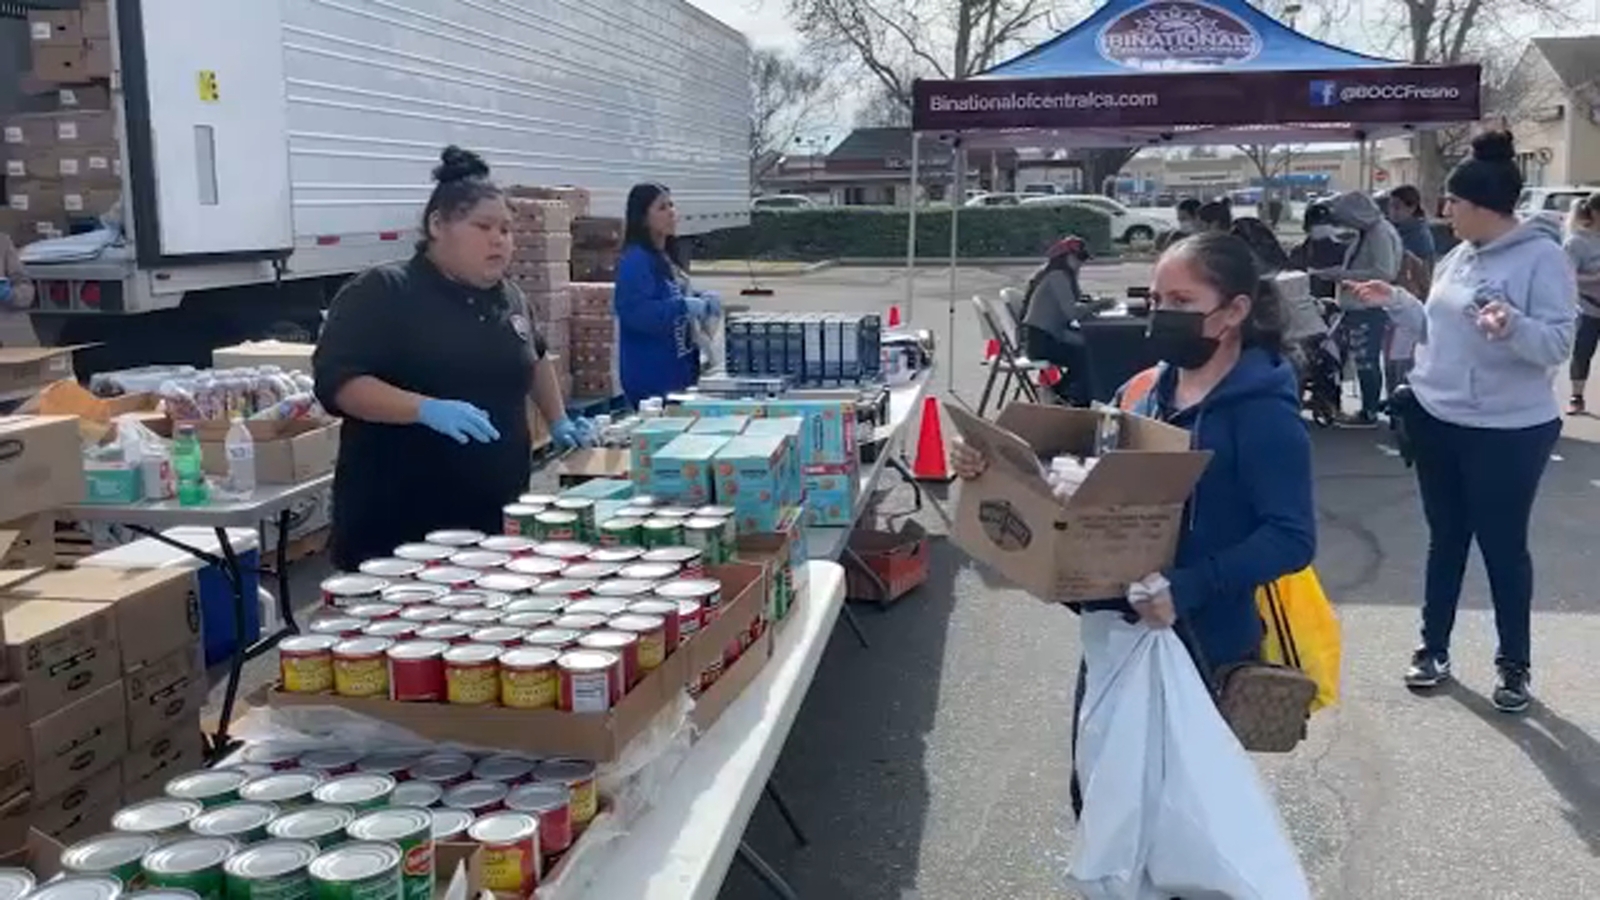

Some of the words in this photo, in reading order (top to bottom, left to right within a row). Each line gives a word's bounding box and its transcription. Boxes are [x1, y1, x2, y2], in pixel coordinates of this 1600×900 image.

[1108, 33, 1250, 47] BINATIONAL
[929, 92, 1158, 111] Binationalofcentralca.com
[1340, 84, 1459, 103] @BOCCFresno
